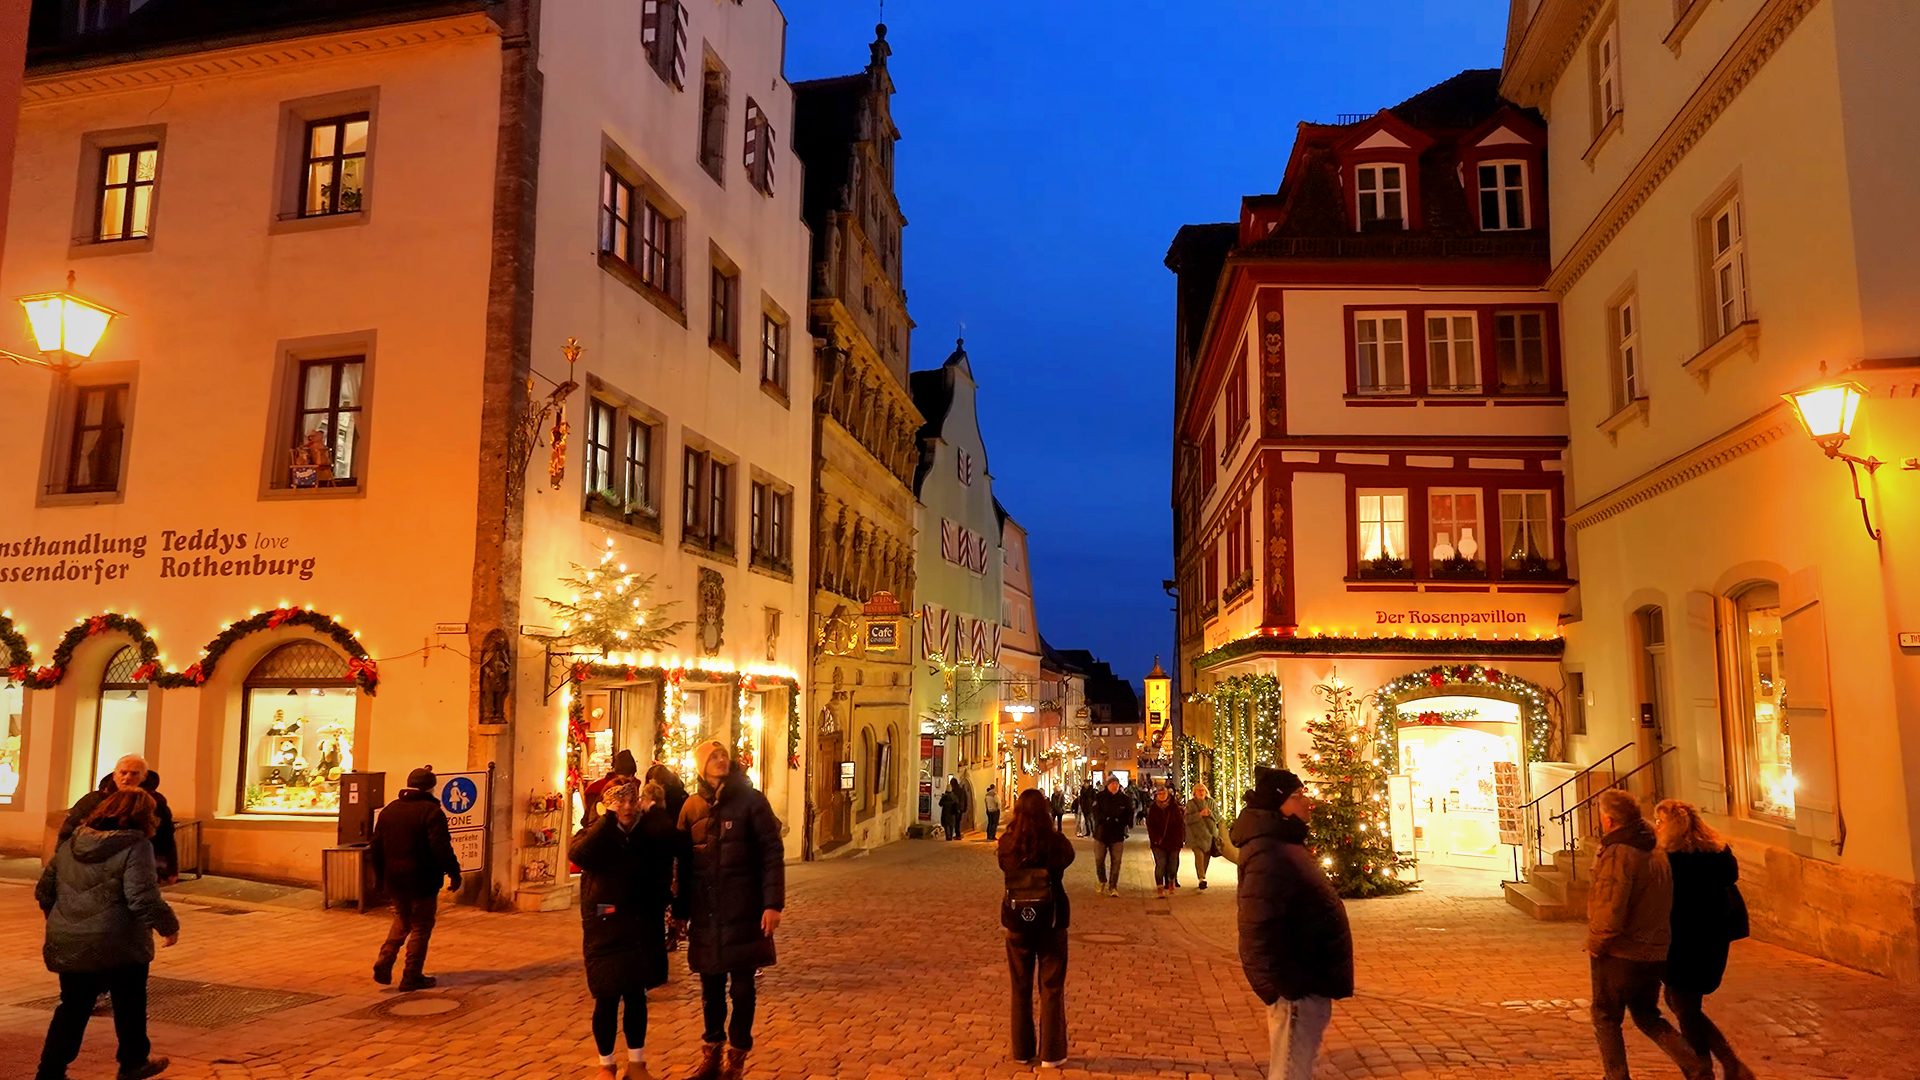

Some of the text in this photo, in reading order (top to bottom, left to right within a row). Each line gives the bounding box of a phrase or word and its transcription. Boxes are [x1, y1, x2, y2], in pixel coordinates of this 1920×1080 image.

[0, 533, 147, 559] nsthandlung
[161, 528, 289, 555] Teddys love
[0, 559, 129, 585] ssendörfer
[160, 554, 316, 581] Rothenburg
[1376, 610, 1526, 626] Der Rosenpavillon
[871, 627, 893, 637] Cafe
